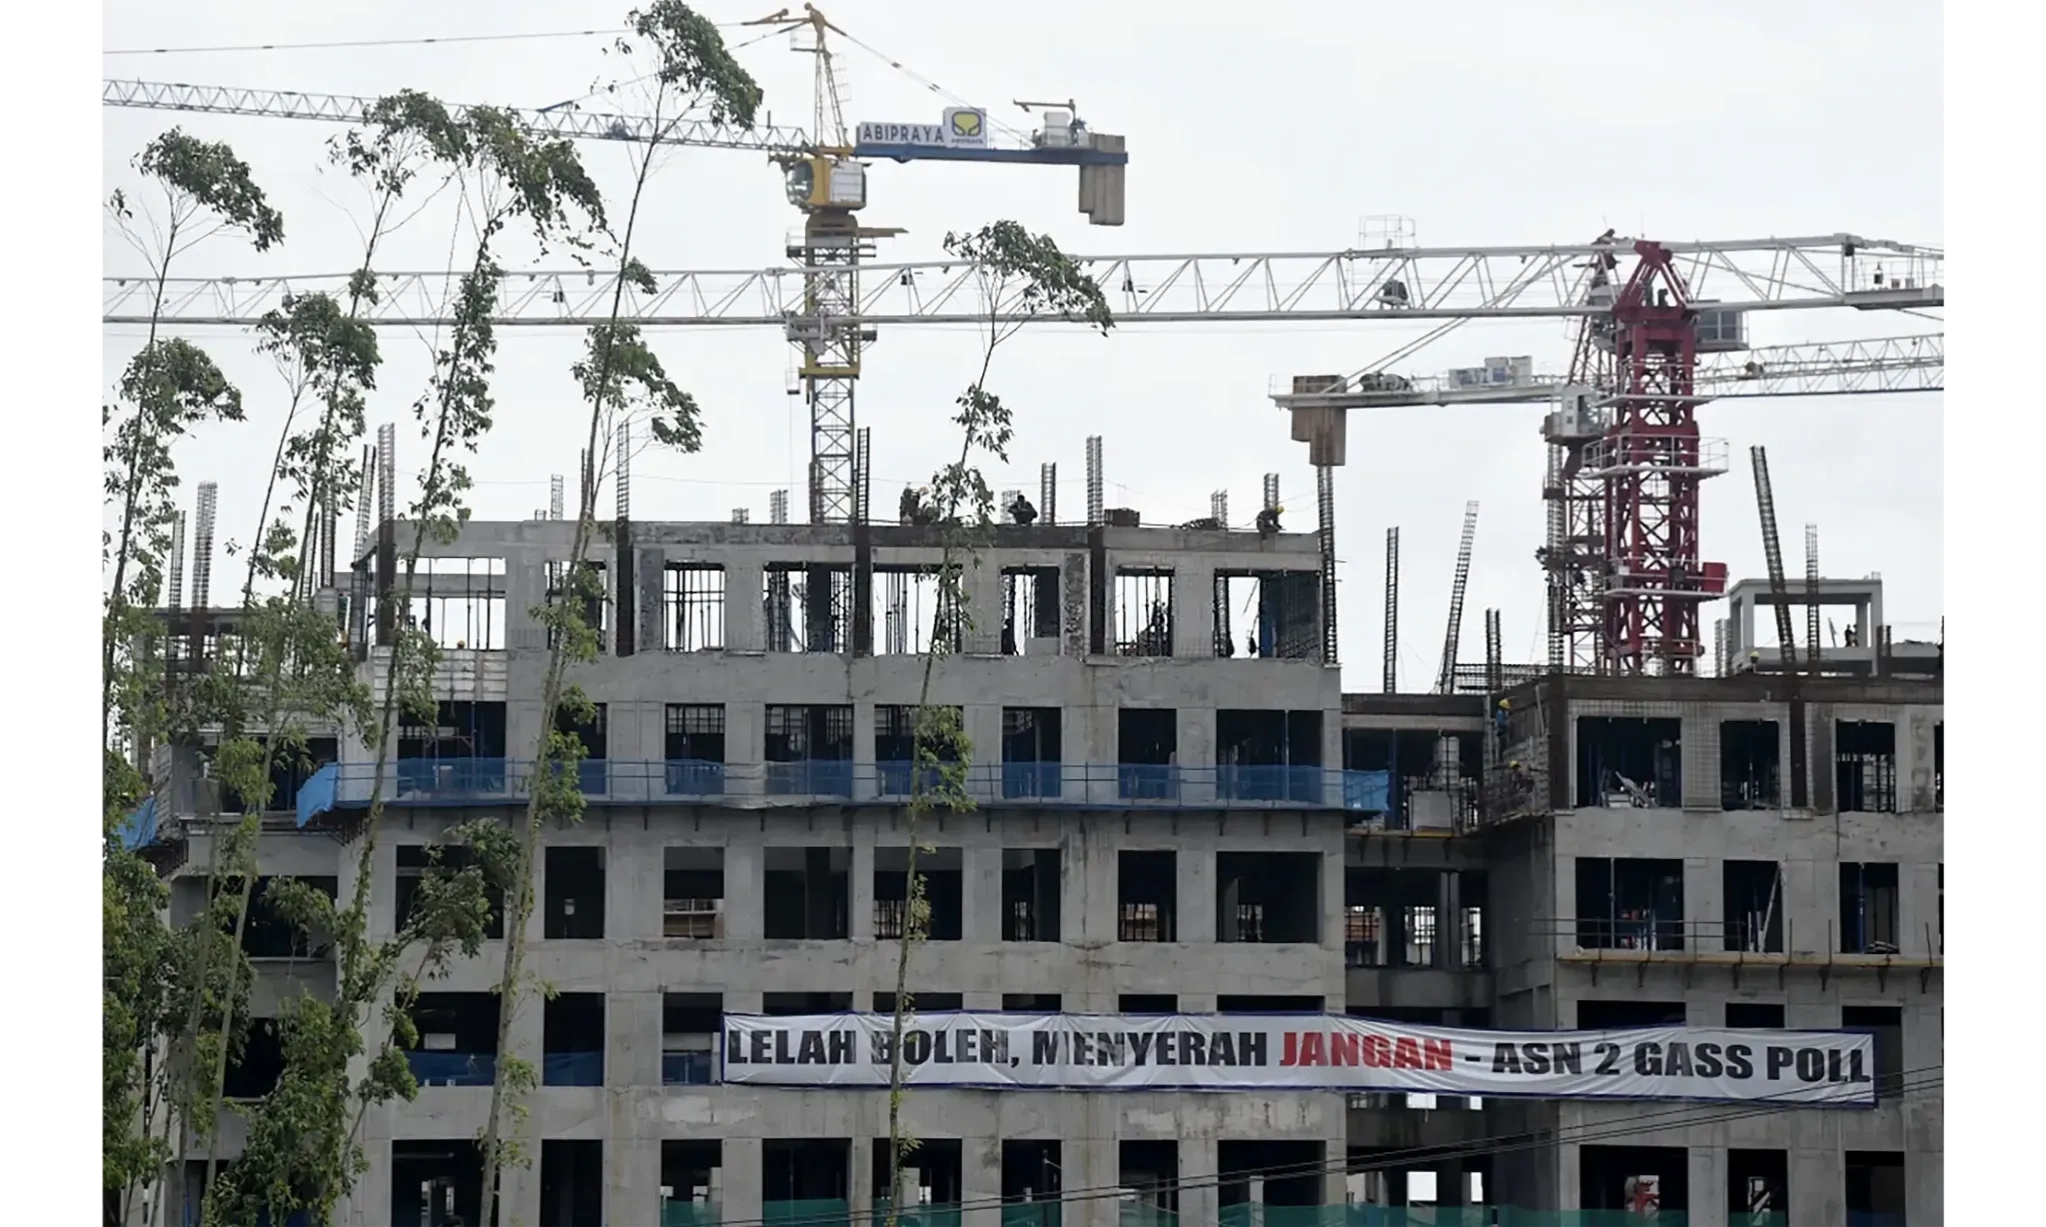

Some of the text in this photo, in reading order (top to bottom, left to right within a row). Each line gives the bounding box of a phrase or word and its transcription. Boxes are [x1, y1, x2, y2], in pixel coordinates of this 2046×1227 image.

[863, 125, 944, 143] ABIPRAYA
[728, 1030, 857, 1065] LELAH
[871, 1029, 1020, 1068] BOLEH,
[1032, 1031, 1267, 1067] MENYERAH
[1280, 1032, 1453, 1071] JANGAN
[1492, 1042, 1582, 1075] ASN
[1595, 1043, 1621, 1075] 2
[1634, 1042, 1754, 1079] GASS
[1767, 1046, 1871, 1083] POLL
